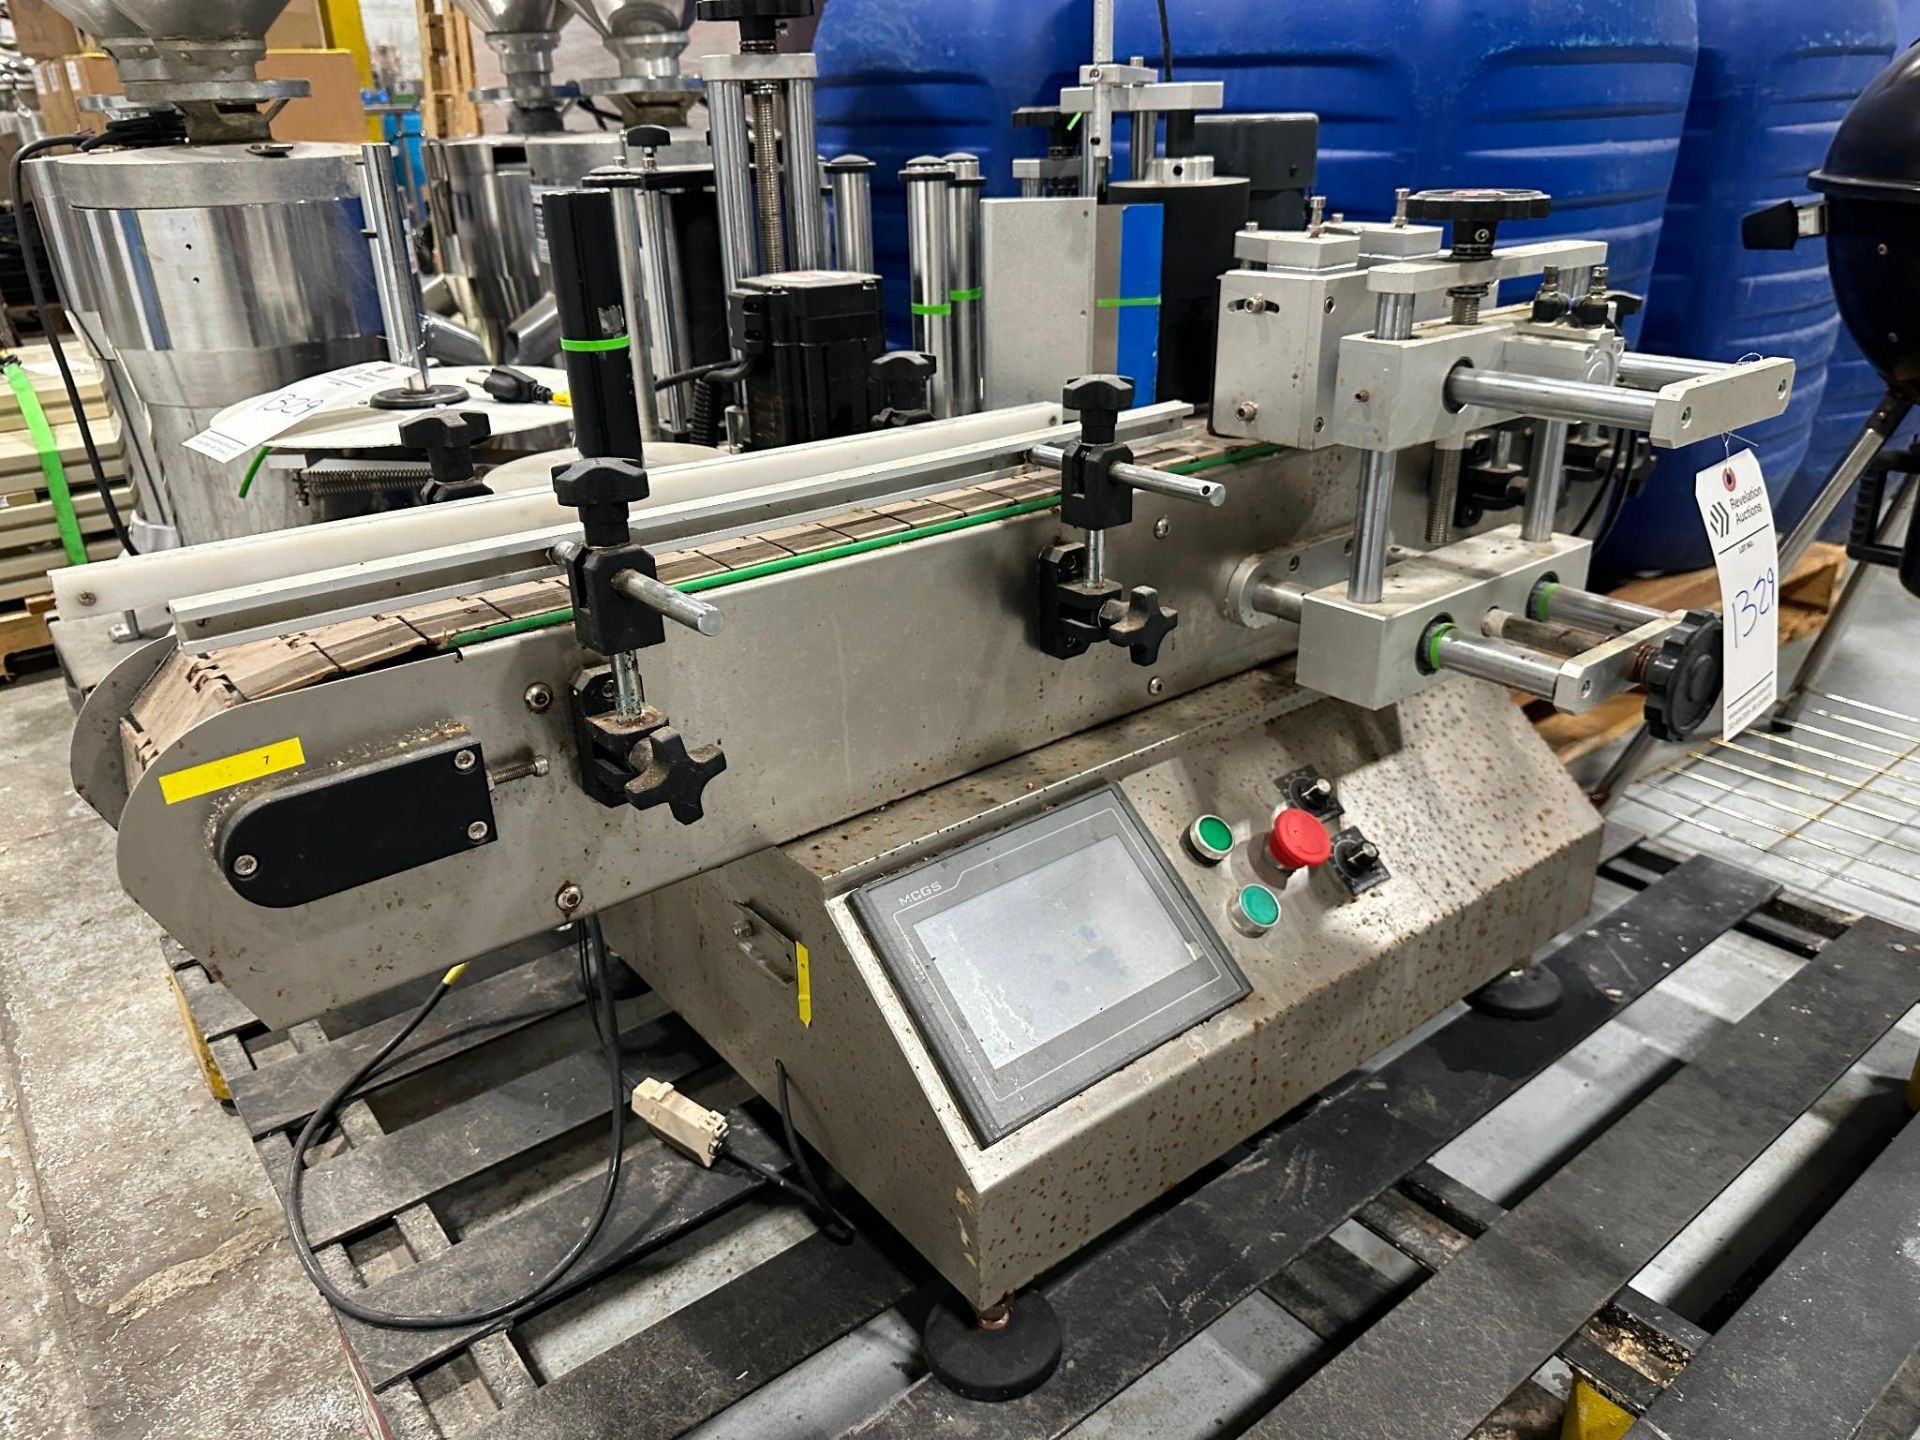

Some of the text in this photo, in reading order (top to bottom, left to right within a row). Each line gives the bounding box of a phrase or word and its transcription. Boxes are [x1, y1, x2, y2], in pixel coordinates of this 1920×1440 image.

[255, 392, 324, 418] 1329
[1729, 486, 1763, 511] Revelation
[1735, 503, 1763, 526] Auctions
[1731, 567, 1775, 649] 1329
[898, 881, 942, 906] MCGS
